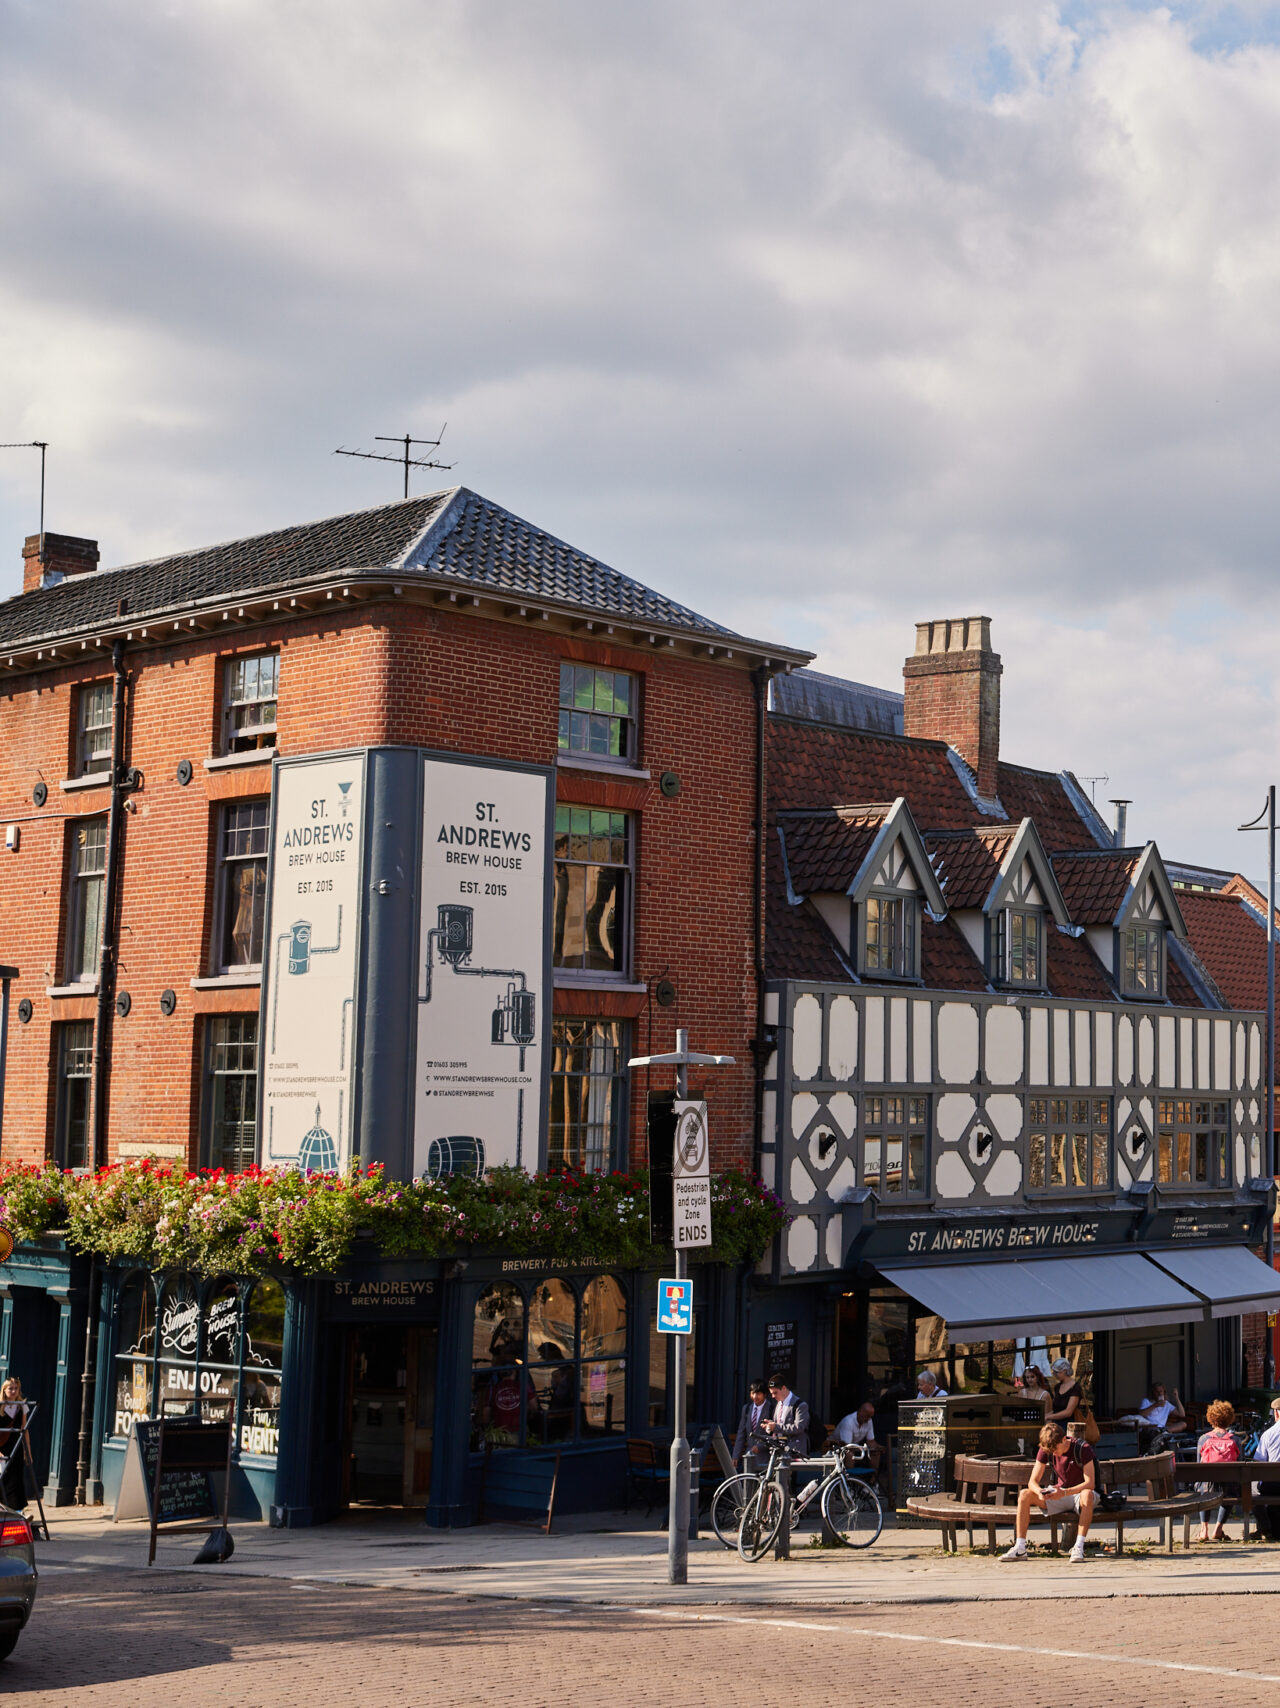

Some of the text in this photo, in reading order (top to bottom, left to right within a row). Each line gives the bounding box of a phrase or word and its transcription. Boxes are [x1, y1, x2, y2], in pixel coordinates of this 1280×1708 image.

[312, 799, 328, 818] ST.
[476, 802, 498, 822] ST.
[283, 822, 353, 848] ANDREWS
[437, 824, 531, 852] ANDREWS
[289, 850, 346, 866] BREW HOUSE
[446, 851, 522, 870] BREW HOUSE
[298, 880, 333, 894] EST. 2015
[460, 881, 507, 896] EST. 2015
[676, 1183, 708, 1194] Pedestrian
[678, 1196, 706, 1206] and cycle
[685, 1209, 700, 1219] Zone
[679, 1225, 707, 1242] ENDS
[908, 1224, 1099, 1251] ST. ANDREWS BREW HOUSE
[335, 1281, 434, 1294] ST. ANDREWS
[210, 1297, 236, 1316] BREW
[352, 1297, 416, 1305] BREW HOUSE
[208, 1312, 238, 1334] HOUSE
[210, 1409, 225, 1419] LIVE
